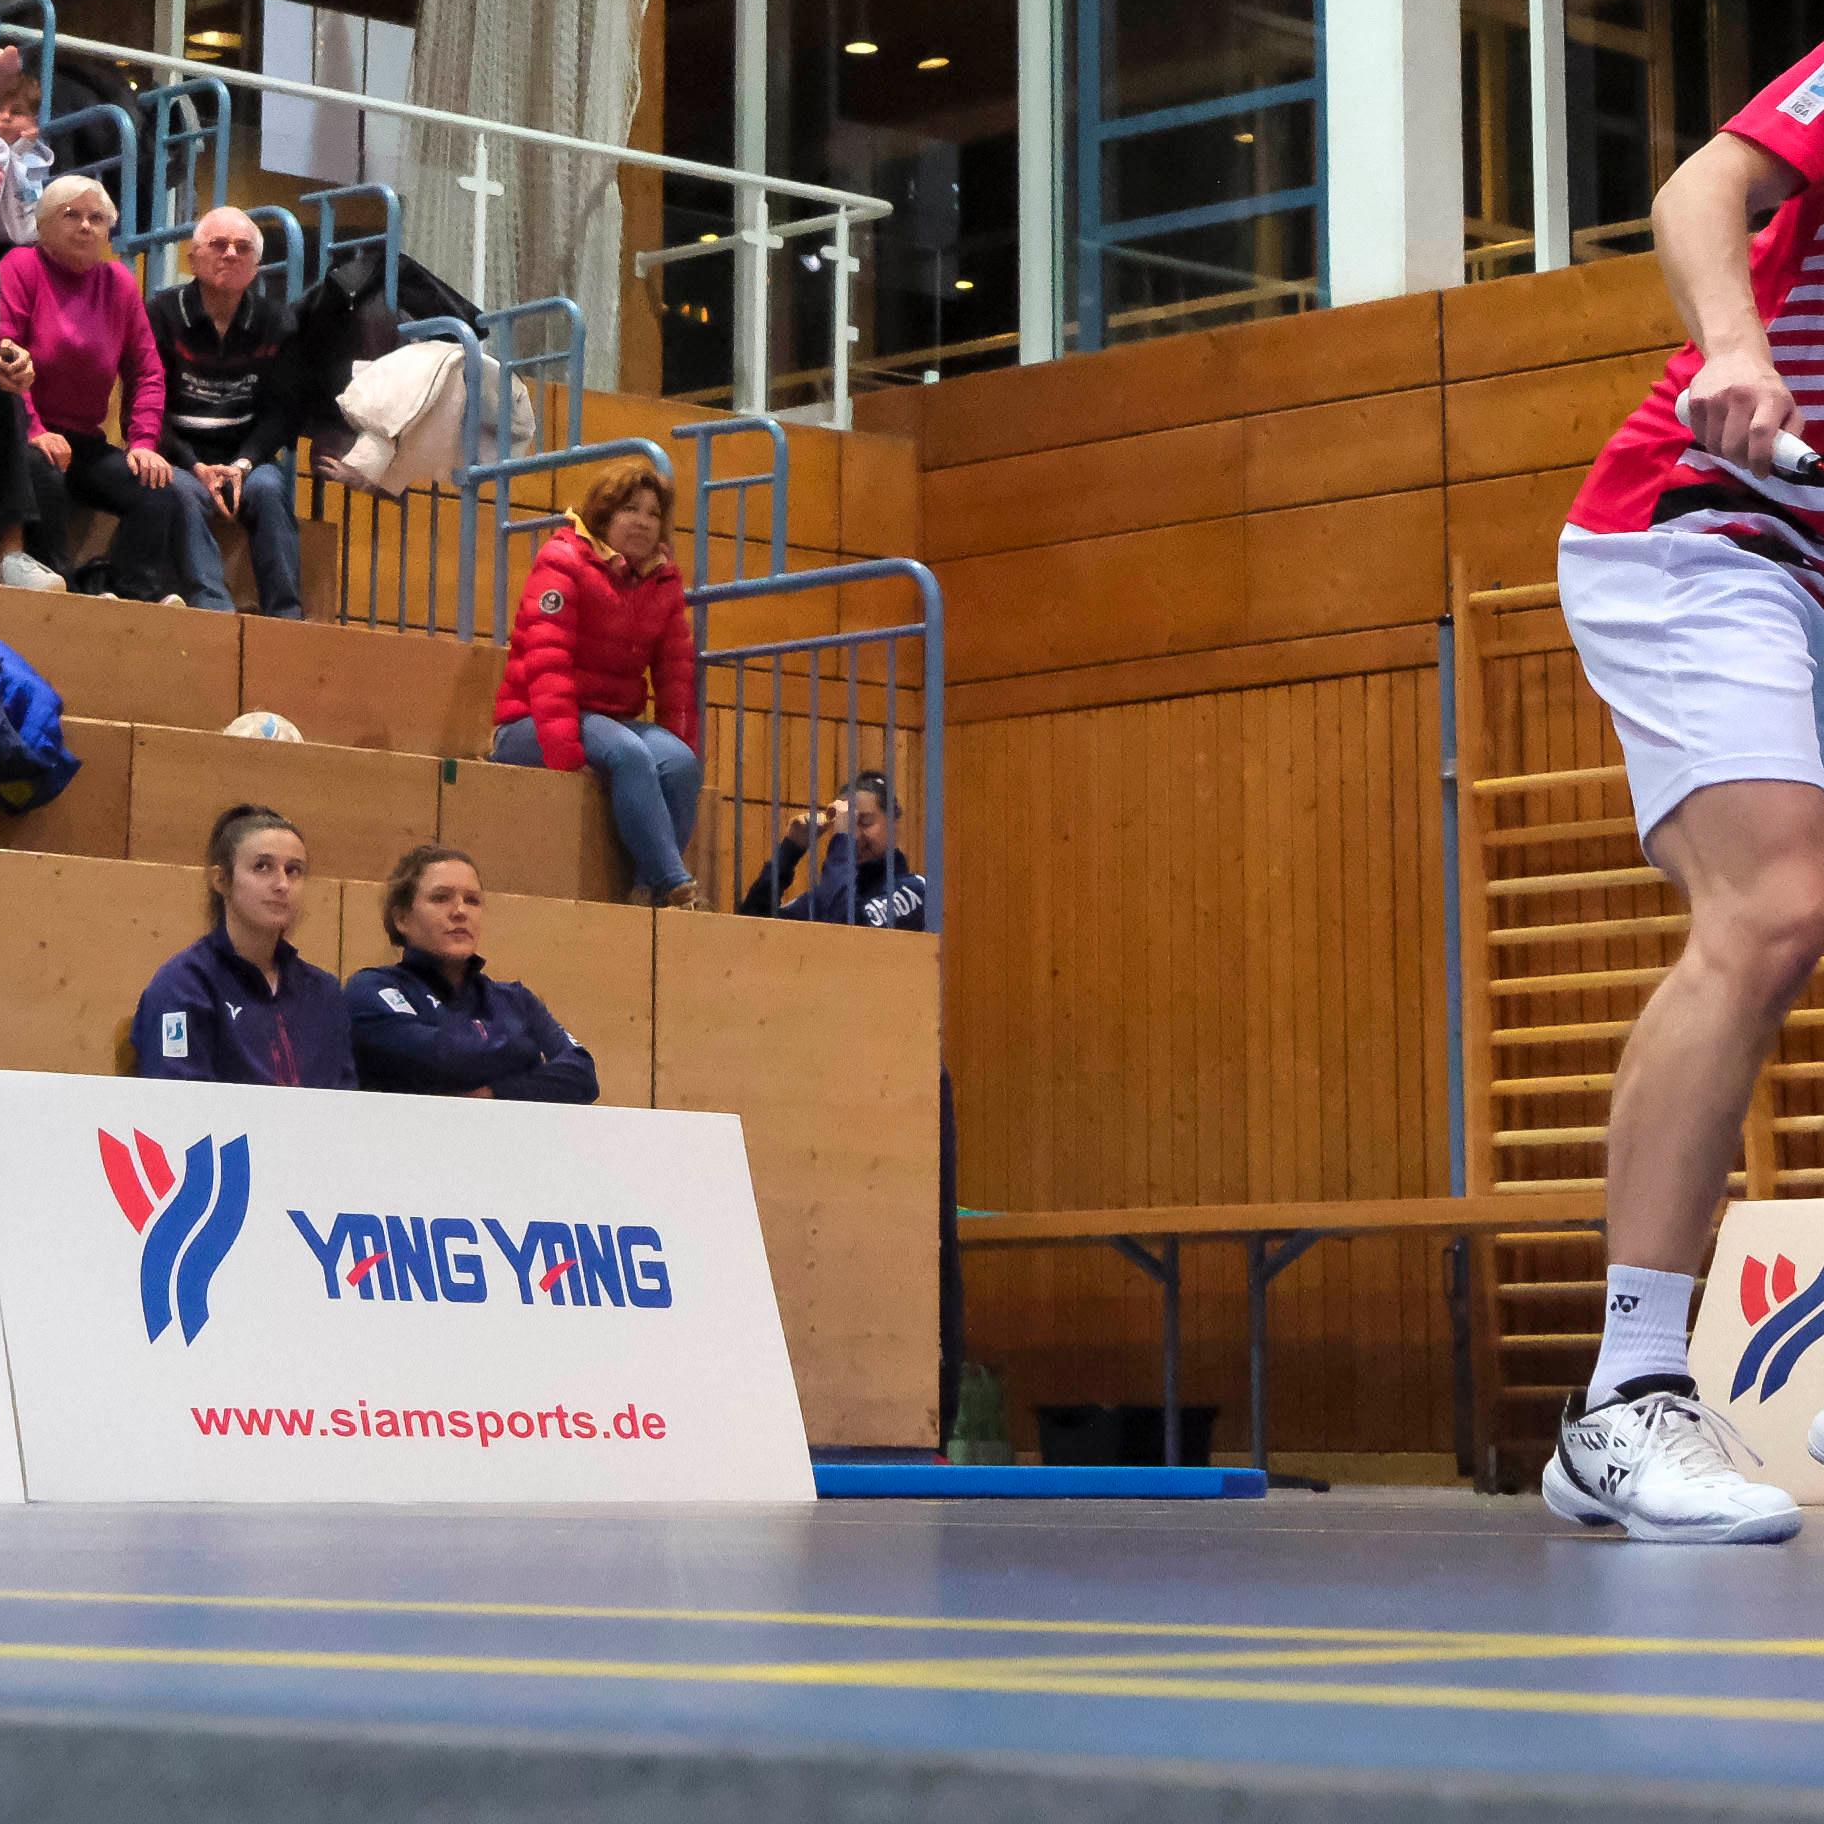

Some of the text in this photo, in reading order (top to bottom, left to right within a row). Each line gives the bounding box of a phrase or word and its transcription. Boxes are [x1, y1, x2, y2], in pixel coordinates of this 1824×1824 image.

[287, 1210, 673, 1309] YANG YANG
[190, 1400, 668, 1449] www.siamsports.de
